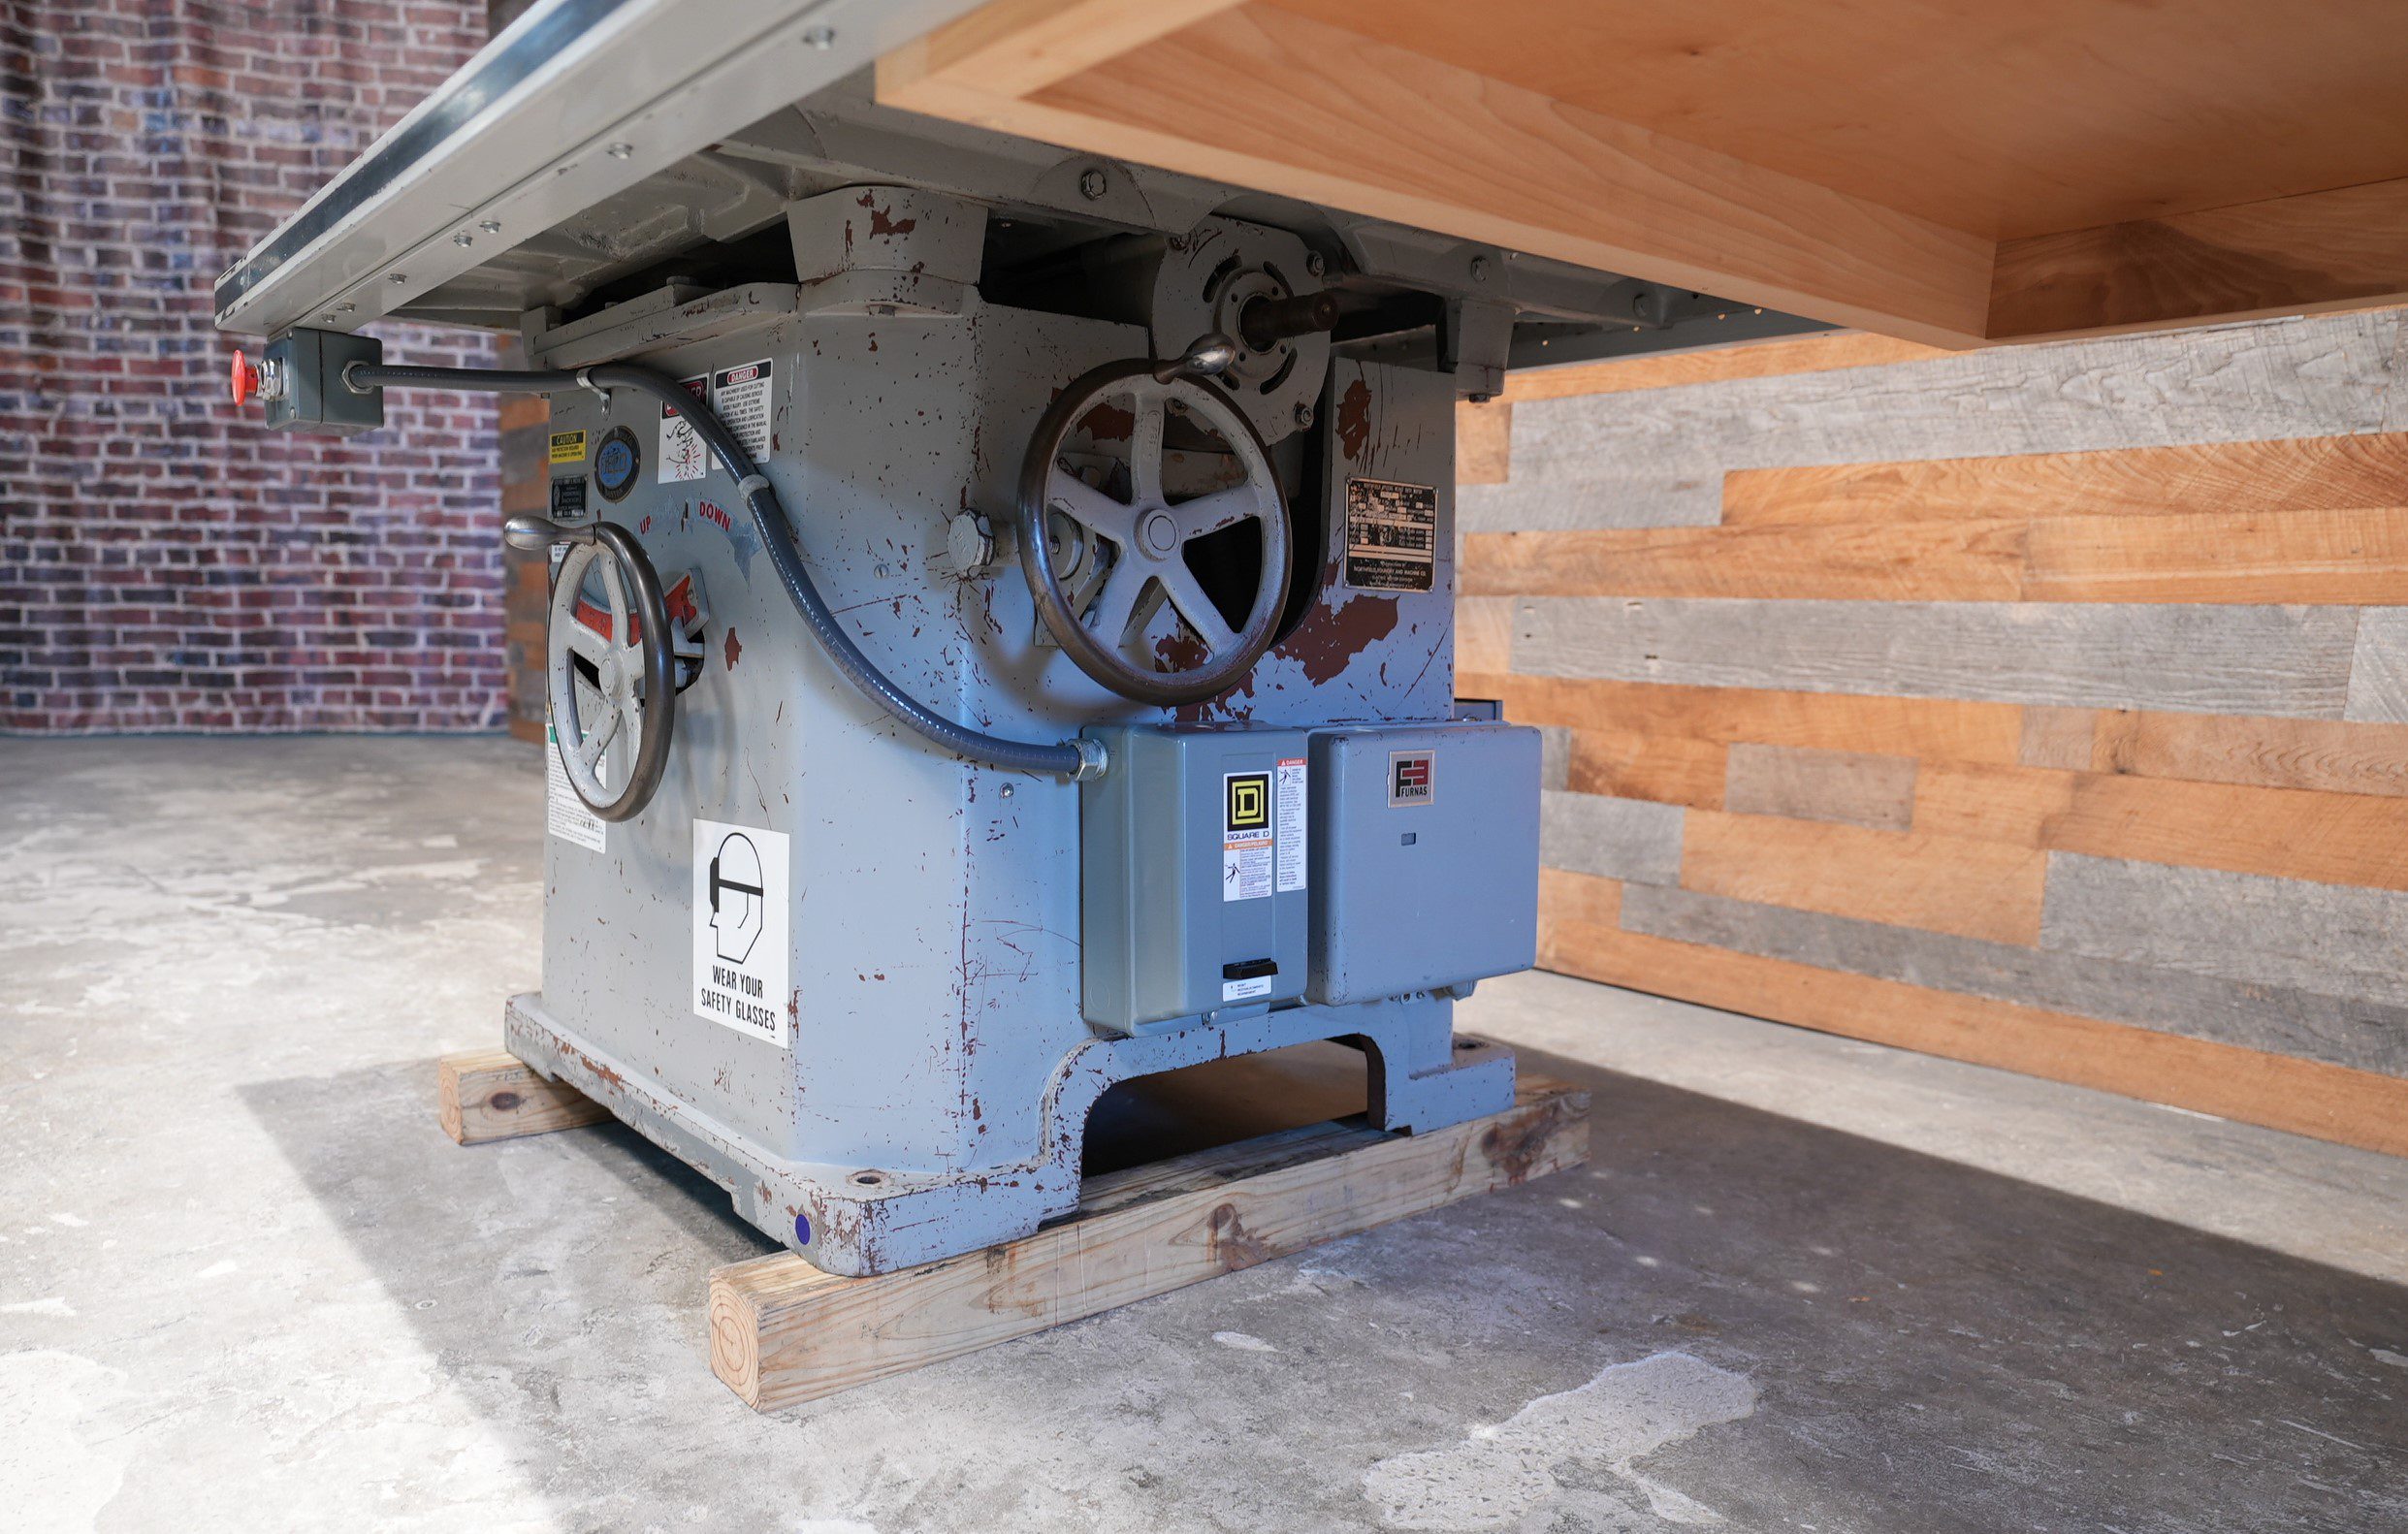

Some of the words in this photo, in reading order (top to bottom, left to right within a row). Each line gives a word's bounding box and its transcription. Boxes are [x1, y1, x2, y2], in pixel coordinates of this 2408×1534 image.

[731, 368, 754, 382] DANGER
[556, 434, 578, 445] CAUTION
[640, 515, 652, 535] UP
[699, 501, 731, 532] DOWN
[1401, 786, 1428, 798] FURNAS
[1227, 831, 1260, 841] SQUARE
[713, 965, 737, 990] WEAR
[740, 974, 763, 999] YOUR
[701, 987, 732, 1015] SAFETY
[736, 1000, 776, 1031] GLASSES
